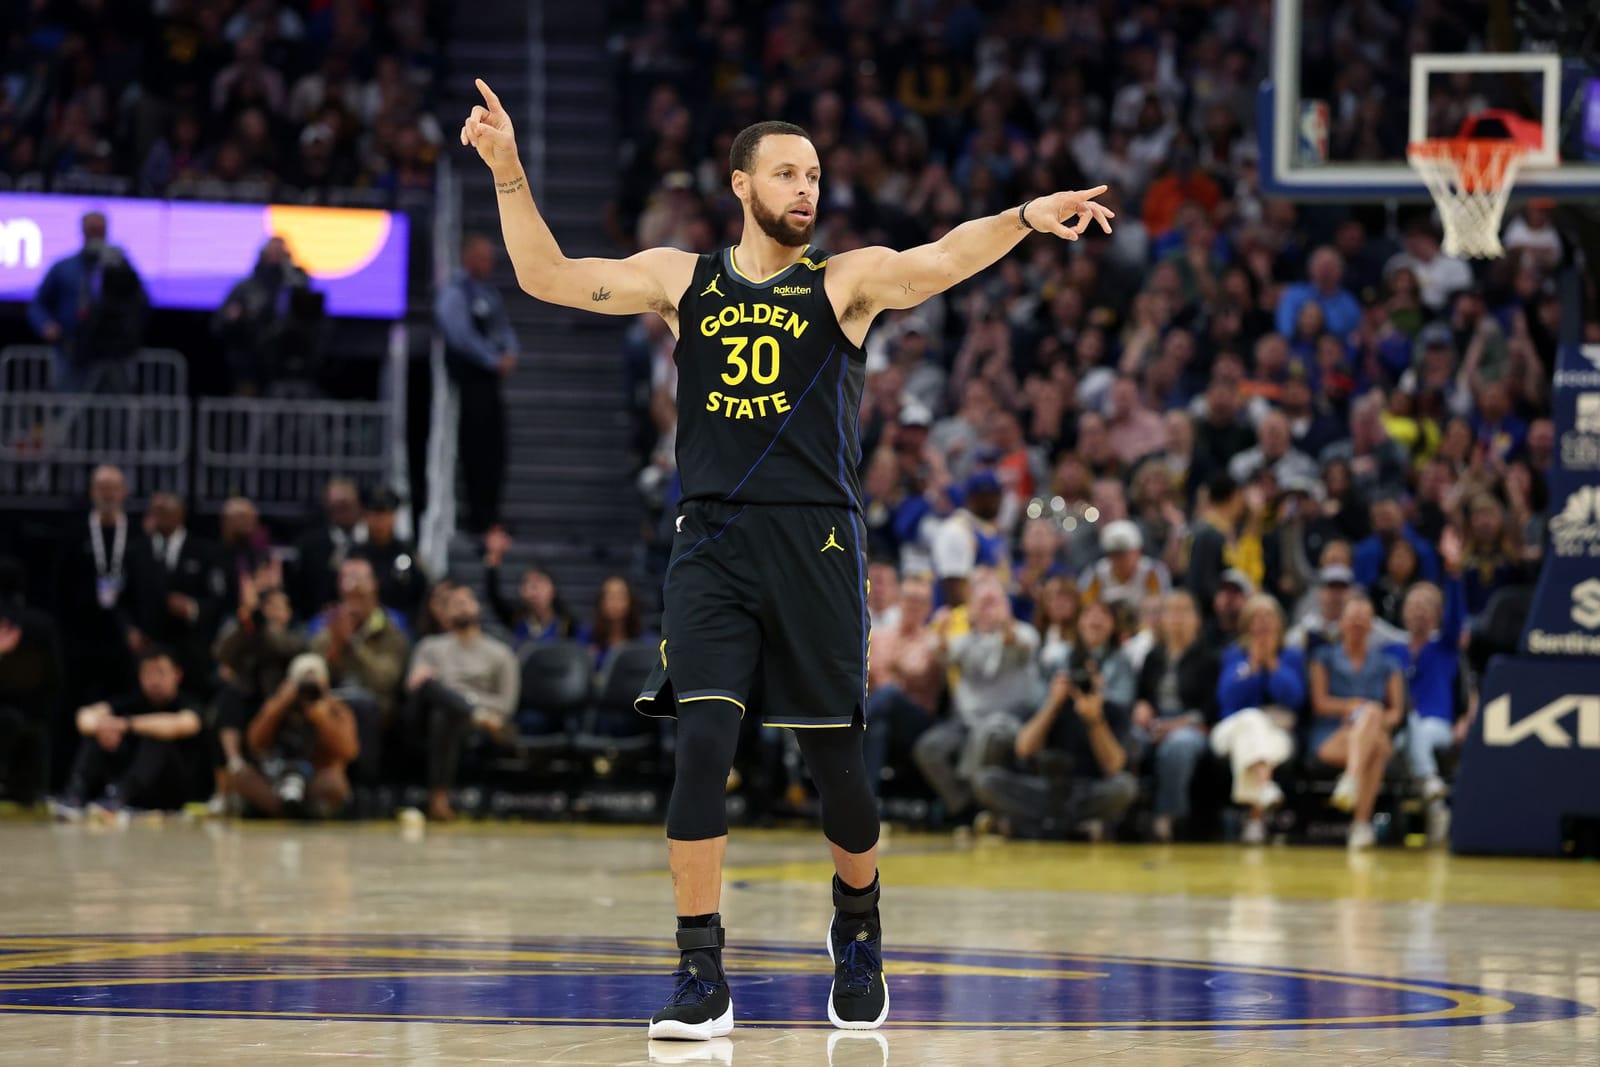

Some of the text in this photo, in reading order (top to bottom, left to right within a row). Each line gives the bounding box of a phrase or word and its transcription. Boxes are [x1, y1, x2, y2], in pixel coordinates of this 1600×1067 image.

[0, 218, 42, 269] n
[773, 285, 812, 296] Rakuten
[700, 302, 809, 339] GOLDEN
[720, 335, 780, 386] 30
[705, 391, 791, 419] STATE
